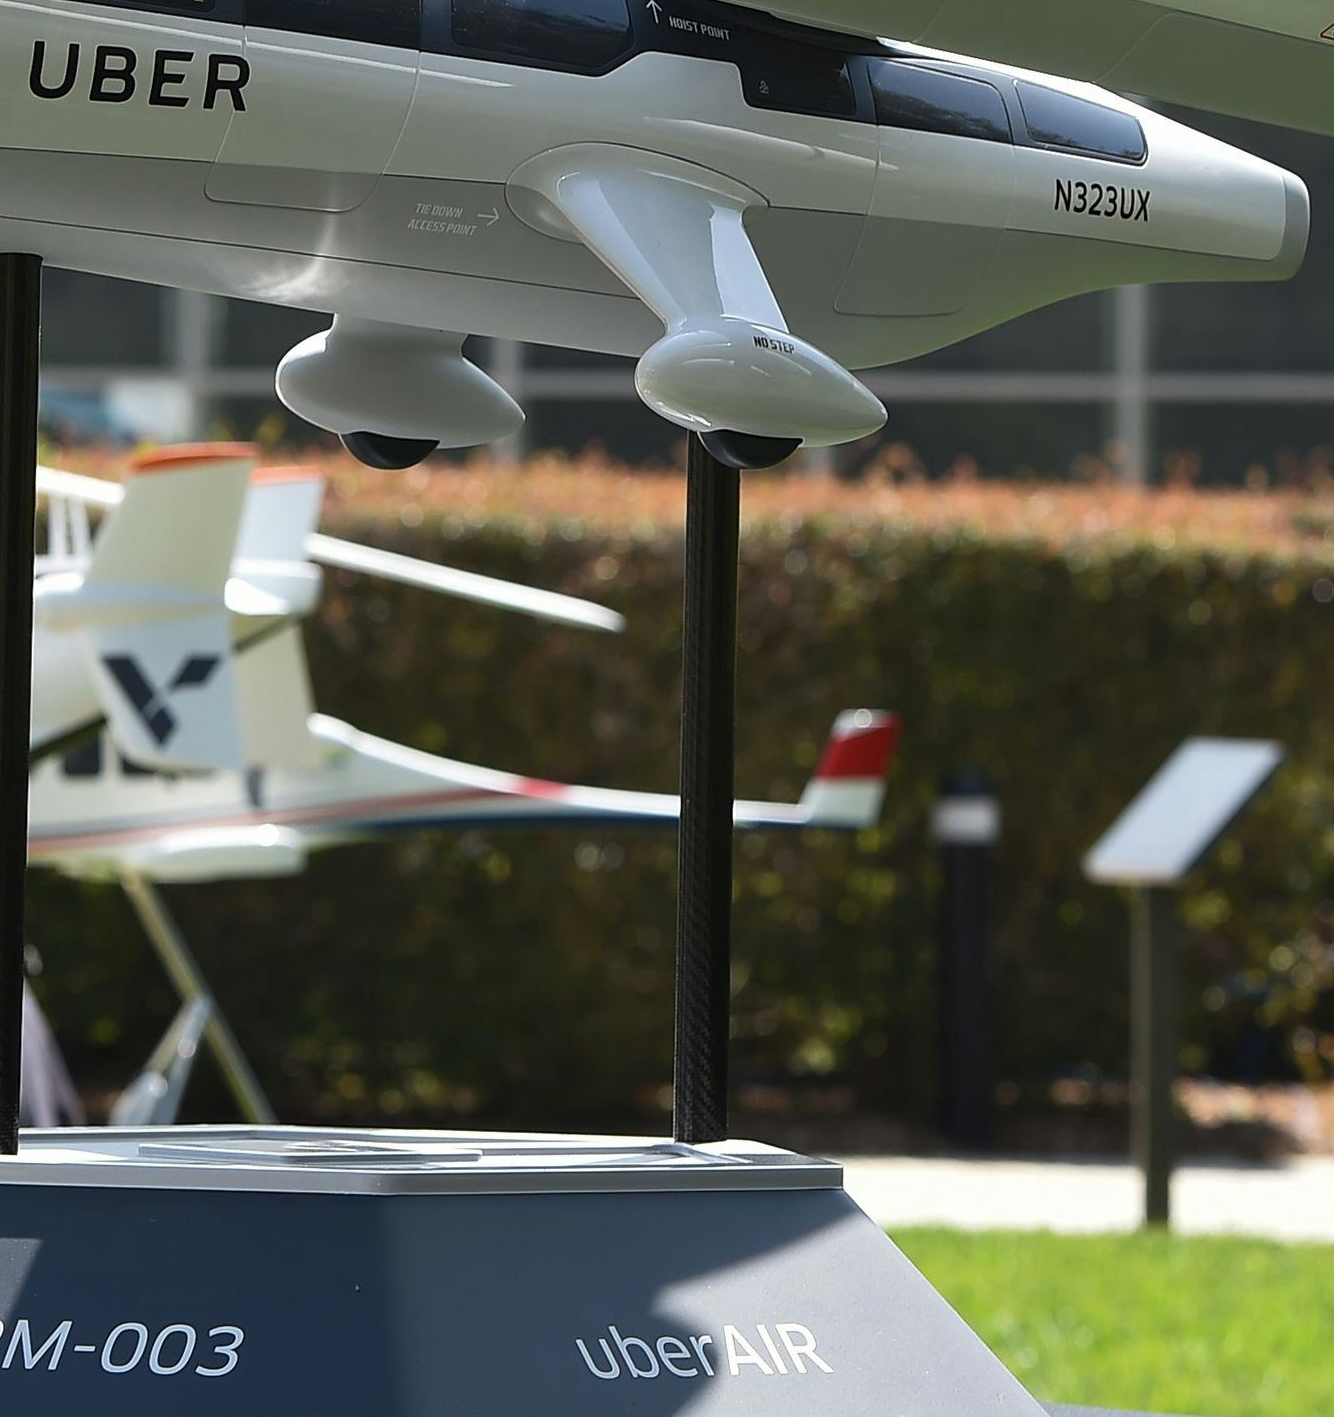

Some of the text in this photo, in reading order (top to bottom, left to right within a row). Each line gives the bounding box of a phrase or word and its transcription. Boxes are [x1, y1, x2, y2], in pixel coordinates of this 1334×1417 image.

[668, 15, 730, 41] HOIST POINT
[28, 39, 251, 112] UBER
[415, 203, 464, 218] TIE DOWN
[1054, 178, 1151, 222] N323UX
[407, 218, 478, 236] ACCESS POINT
[752, 335, 795, 355] NO STEP
